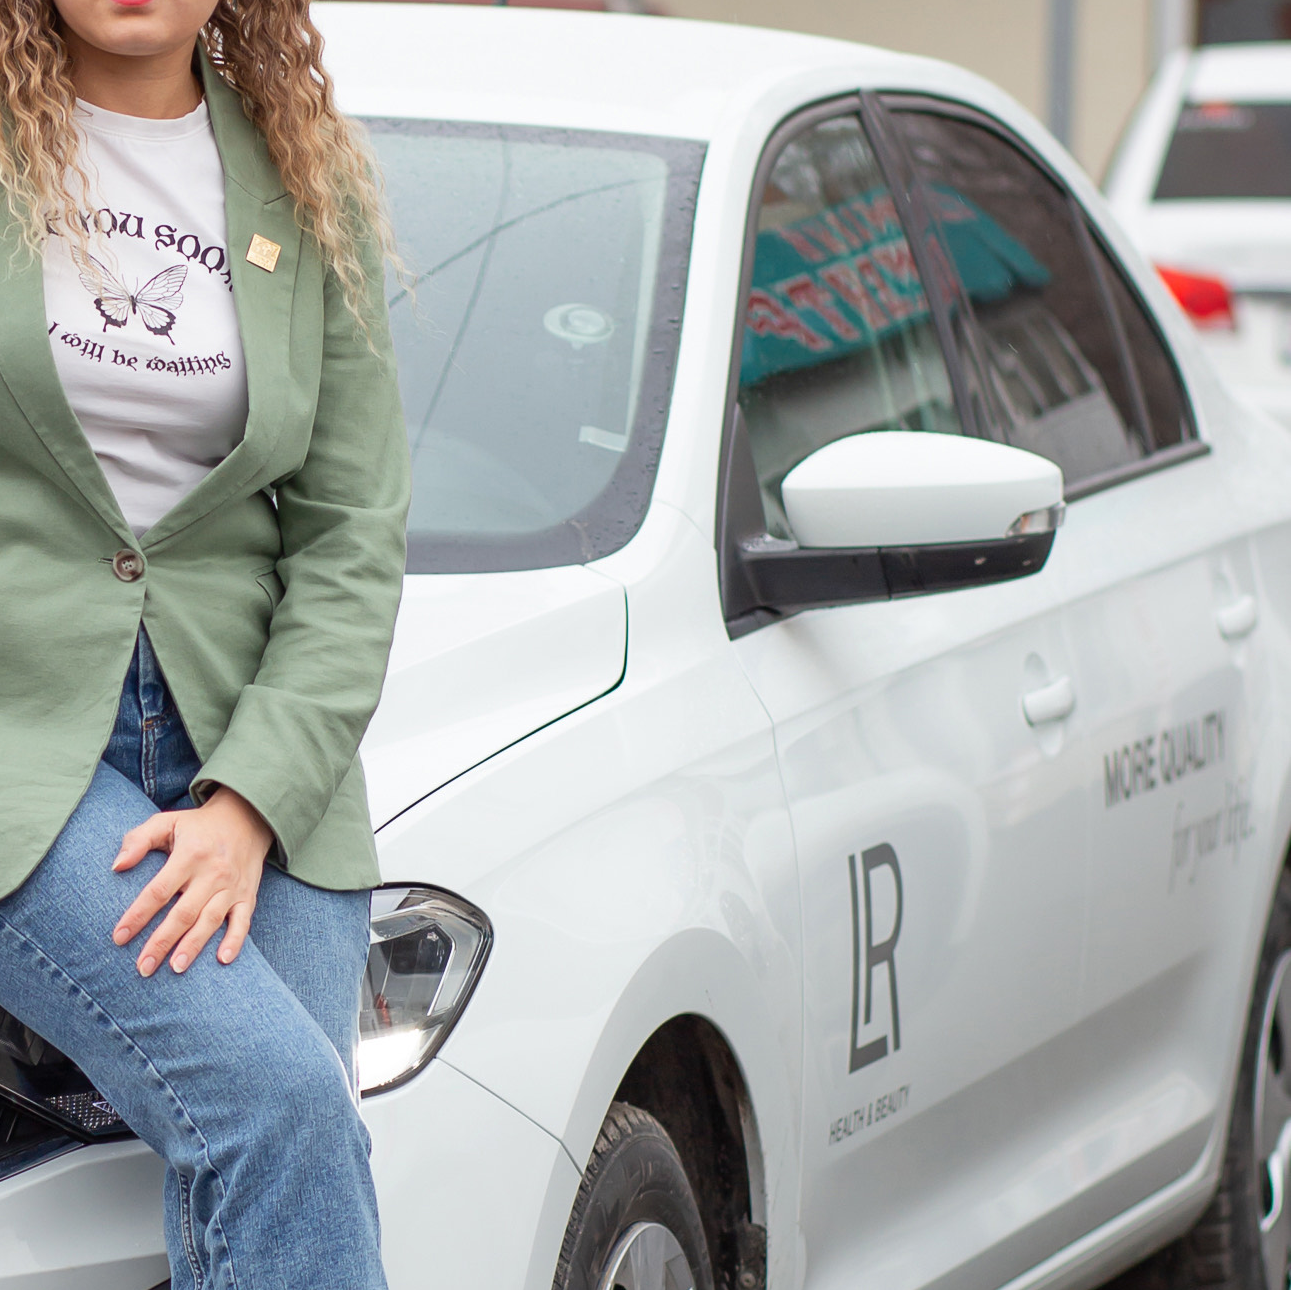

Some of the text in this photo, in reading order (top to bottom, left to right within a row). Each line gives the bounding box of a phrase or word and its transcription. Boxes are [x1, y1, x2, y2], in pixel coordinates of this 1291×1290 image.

[61, 330, 105, 363] will
[111, 349, 138, 371] be
[146, 350, 232, 377] waiting
[1103, 735, 1158, 809] MORE
[848, 841, 904, 1075] LR
